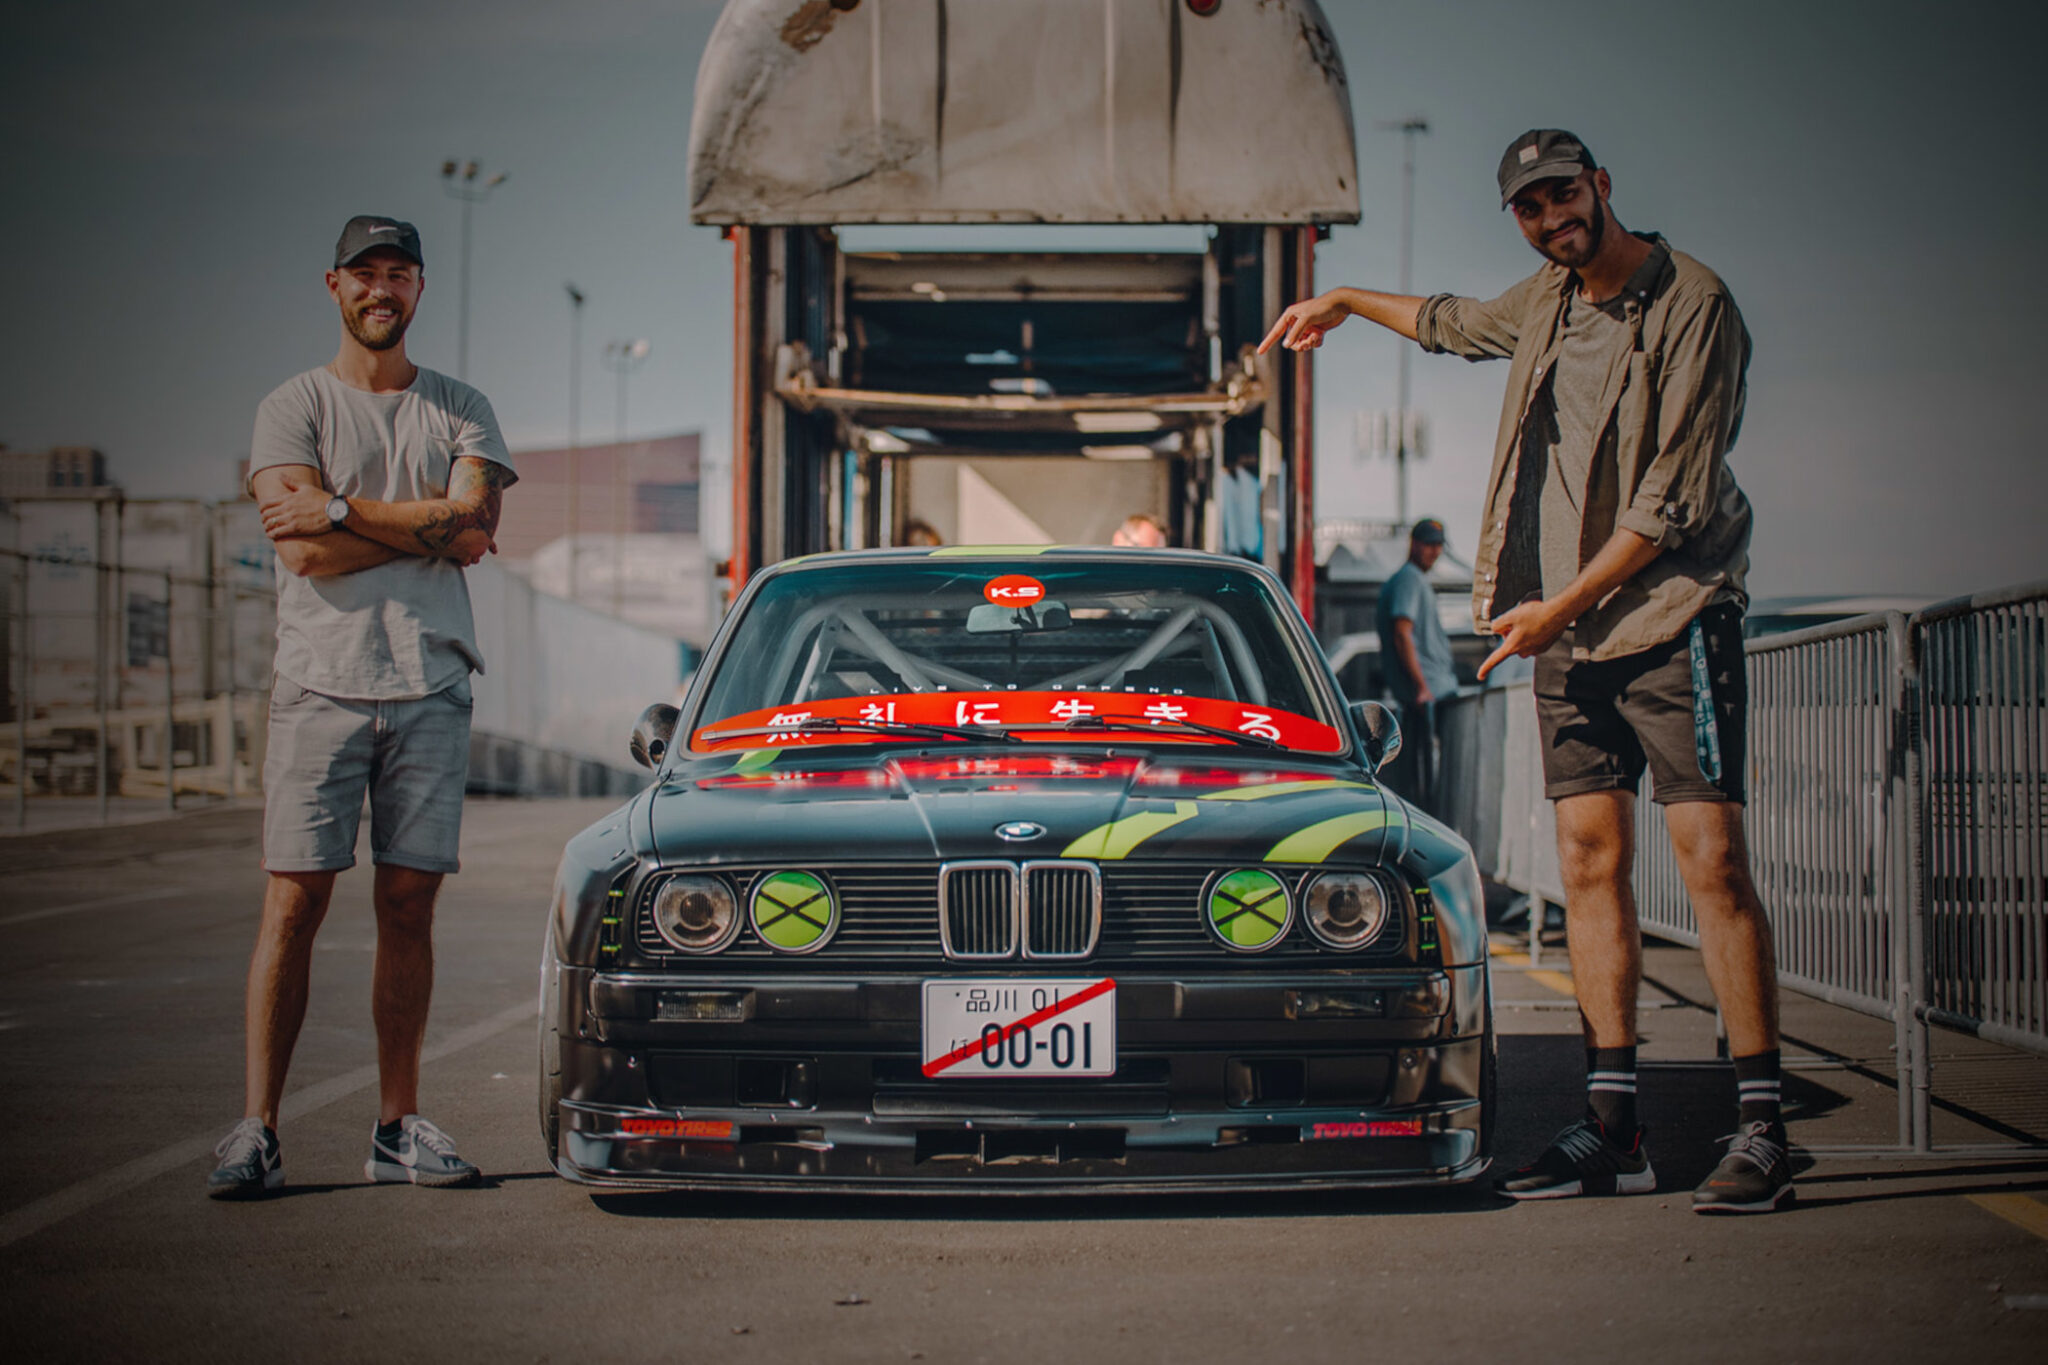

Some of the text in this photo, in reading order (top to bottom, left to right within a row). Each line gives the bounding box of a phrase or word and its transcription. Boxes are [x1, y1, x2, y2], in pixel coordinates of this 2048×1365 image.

[991, 586, 1040, 598] K.S
[870, 685, 947, 695] LIVE
[1052, 684, 1183, 695] OFFEND
[966, 989, 1017, 1013] 品川
[981, 1022, 1092, 1069] 00-01
[621, 1119, 675, 1136] TOYO
[1312, 1122, 1368, 1138] TOYO
